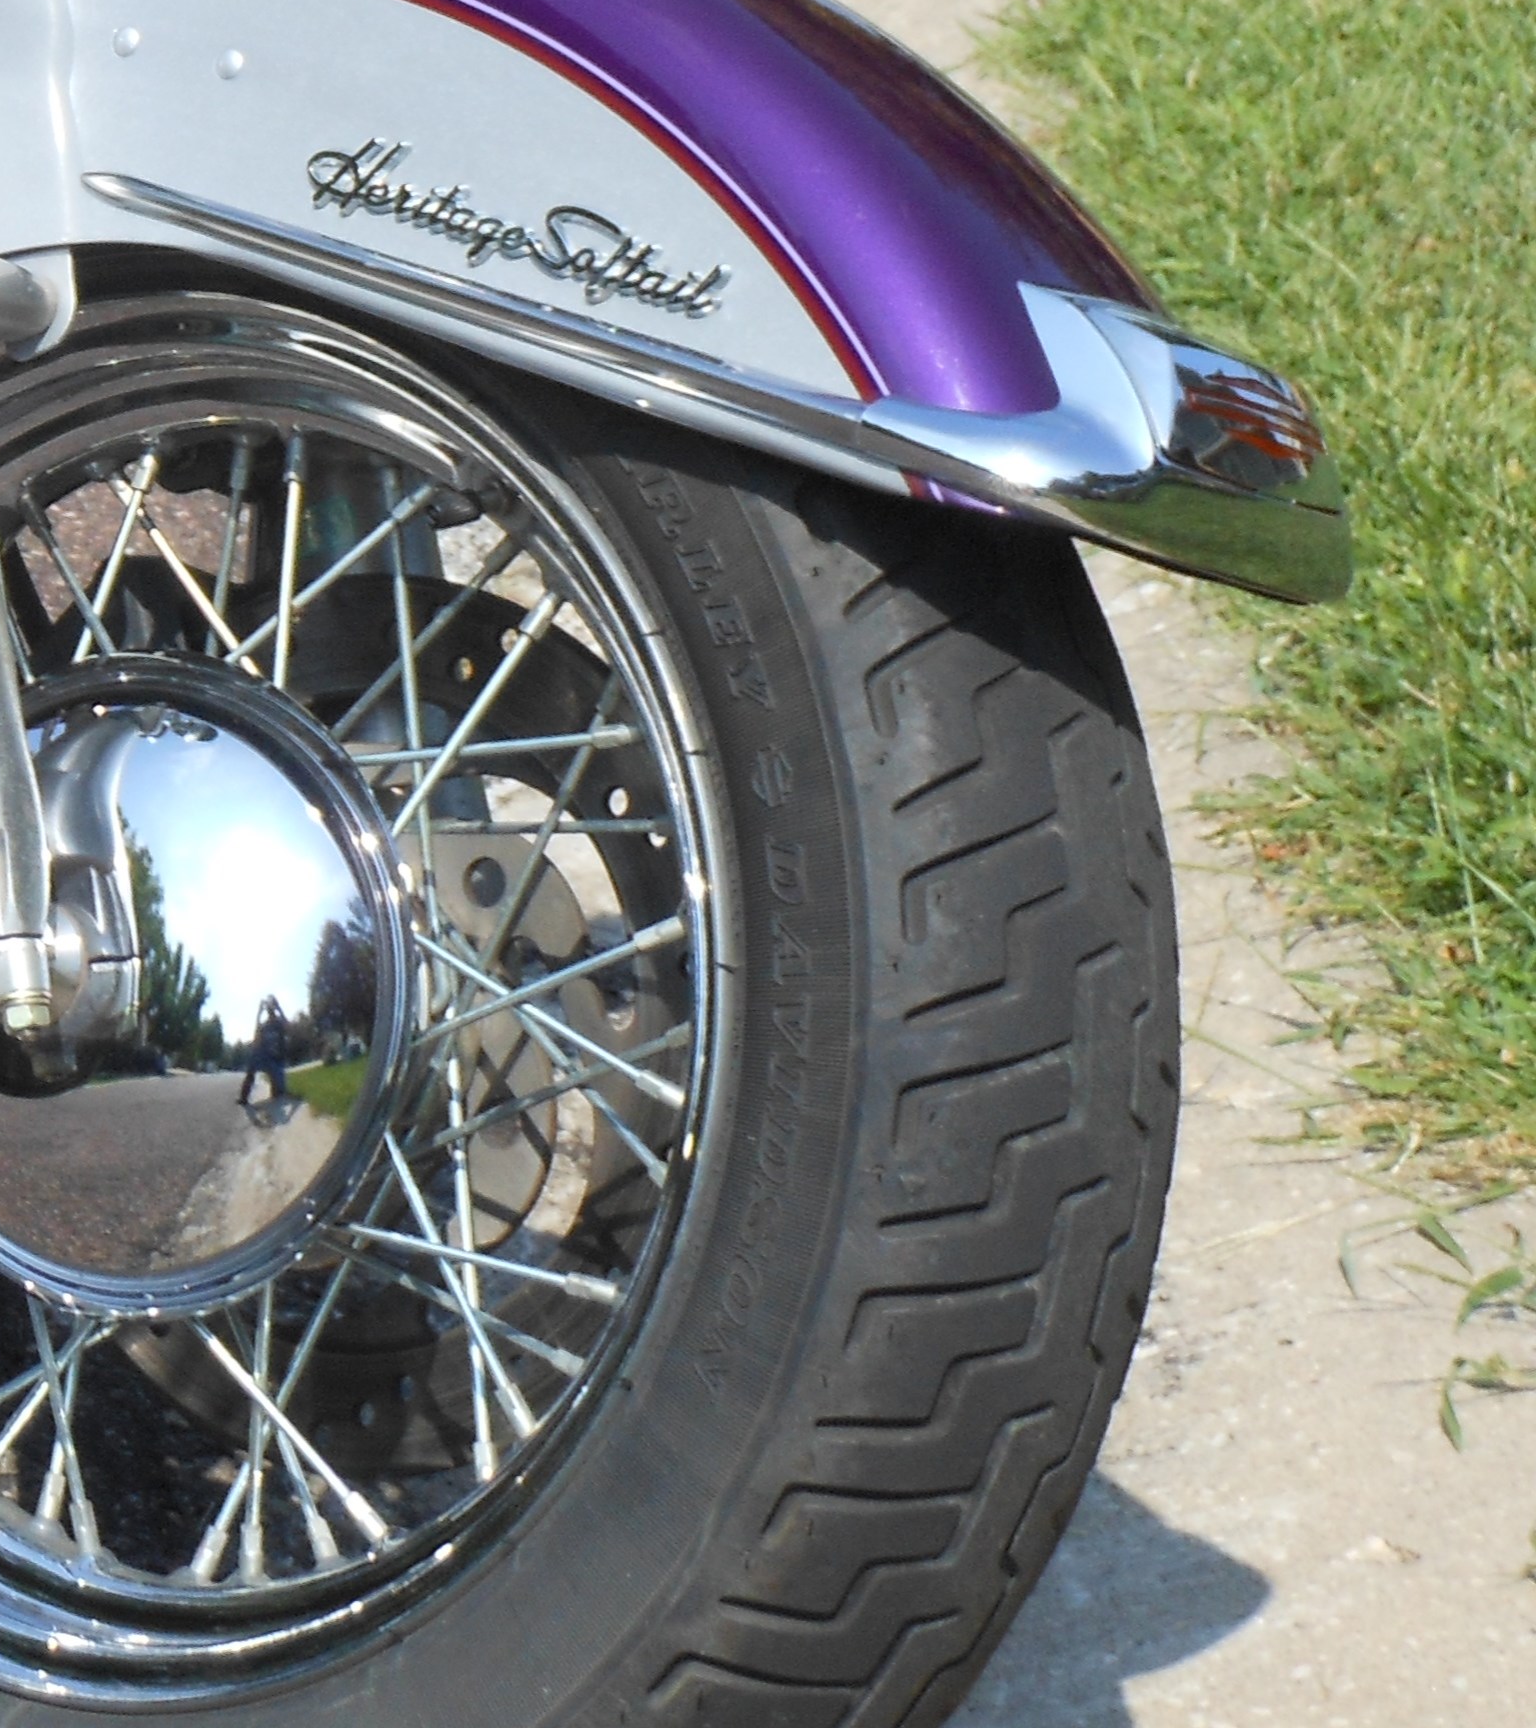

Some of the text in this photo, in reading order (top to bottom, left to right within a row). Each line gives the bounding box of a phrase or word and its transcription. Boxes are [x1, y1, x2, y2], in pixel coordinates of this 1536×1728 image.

[307, 135, 733, 320] Heritage Softail
[692, 834, 811, 1400] DAVIDSON
